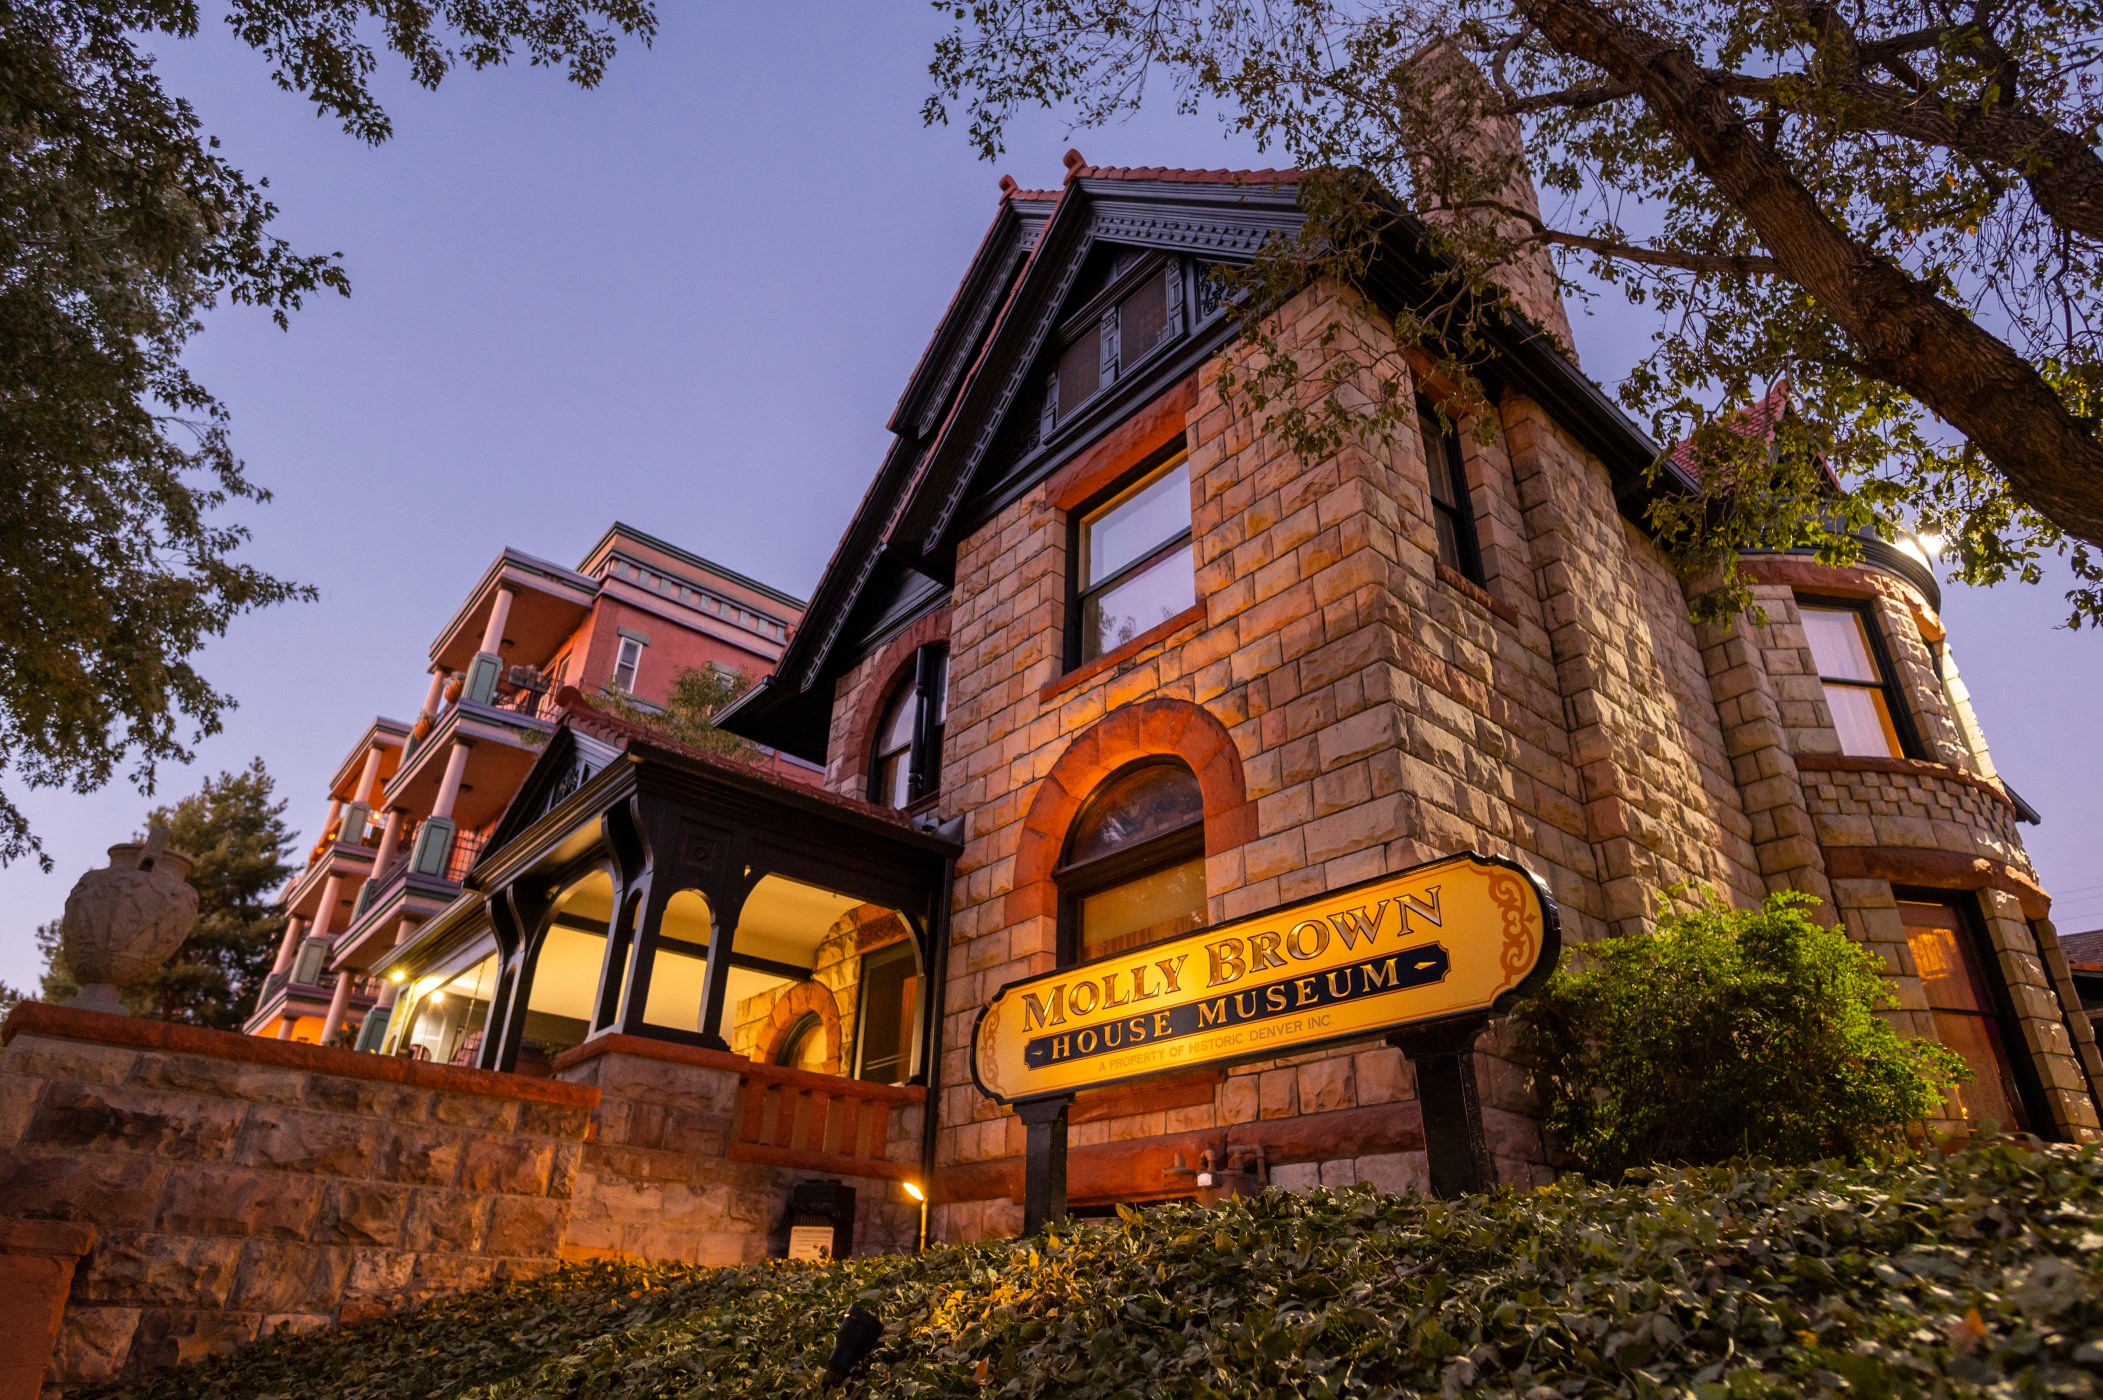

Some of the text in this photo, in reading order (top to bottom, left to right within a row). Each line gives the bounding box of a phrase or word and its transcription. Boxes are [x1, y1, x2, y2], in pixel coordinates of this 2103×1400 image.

[1021, 885, 1442, 1032] MOLLY BROWN
[1052, 957, 1401, 1060] HOUSE MUSEUM
[1098, 1014, 1335, 1072] A PROPERTY OF HISTORIC DENVER INC.
